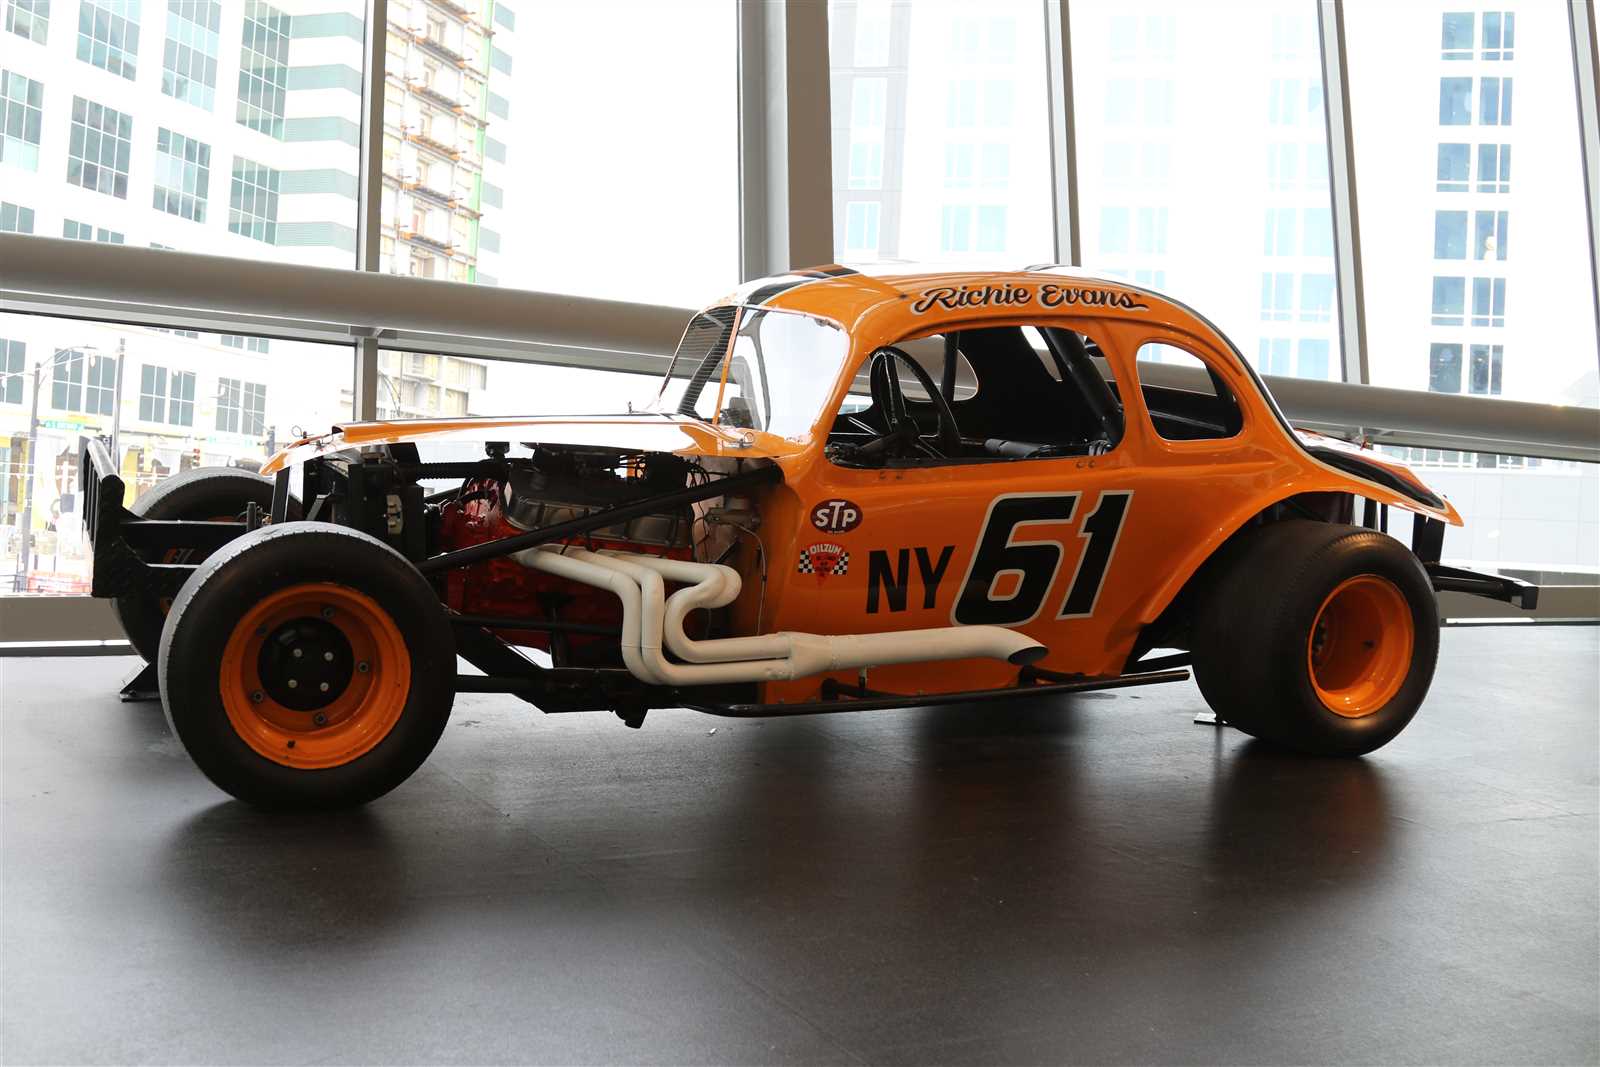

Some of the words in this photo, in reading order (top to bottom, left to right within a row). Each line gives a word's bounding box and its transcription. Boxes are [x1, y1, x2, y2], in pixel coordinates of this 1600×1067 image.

[911, 283, 1032, 314] Richie
[1039, 284, 1149, 311] Evans
[815, 501, 857, 528] STP
[809, 544, 842, 555] OILZUM
[866, 545, 955, 614] NY
[950, 490, 1134, 627] 61
